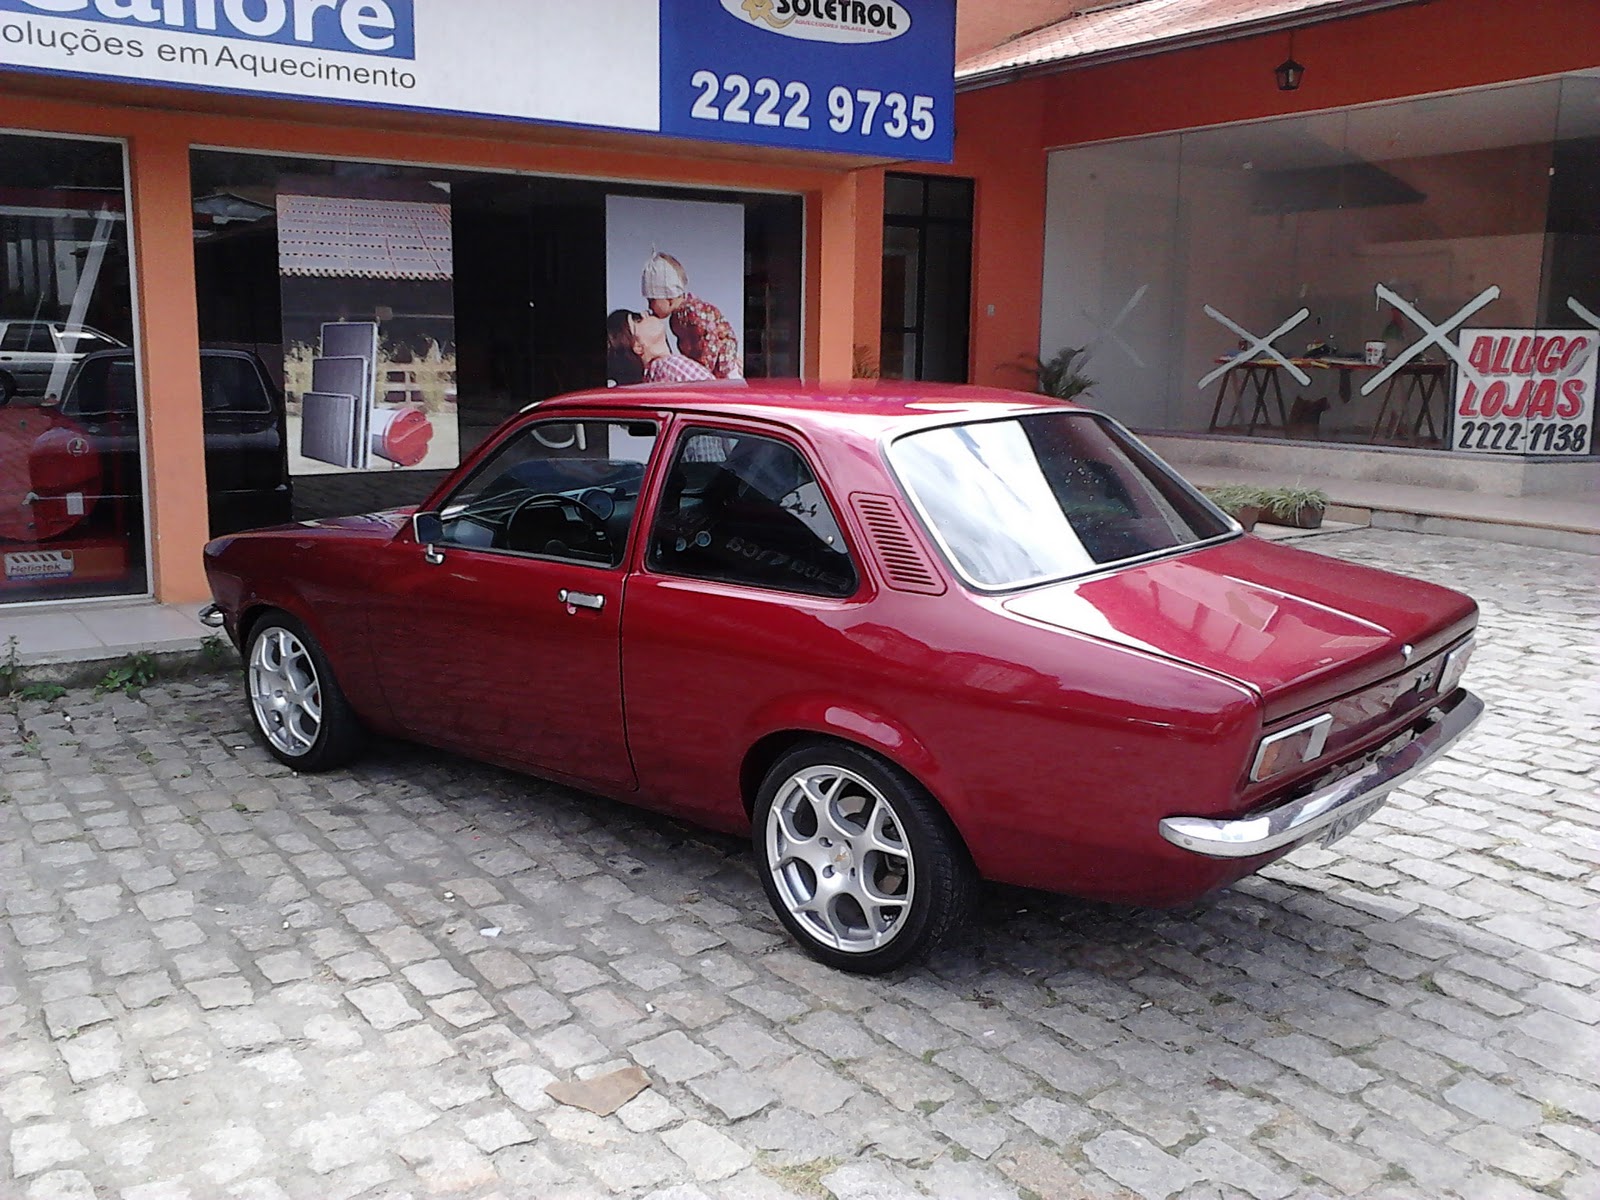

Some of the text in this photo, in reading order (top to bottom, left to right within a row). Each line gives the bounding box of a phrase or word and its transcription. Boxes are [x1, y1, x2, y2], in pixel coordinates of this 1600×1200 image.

[776, 0, 897, 30] SOLETROL
[2, 20, 144, 58] oluções
[157, 45, 208, 65] em
[214, 45, 417, 89] Aquecimento
[691, 70, 935, 141] 2222 9735
[1458, 379, 1586, 419] LOJAS
[1458, 420, 1588, 453] 2222-1138
